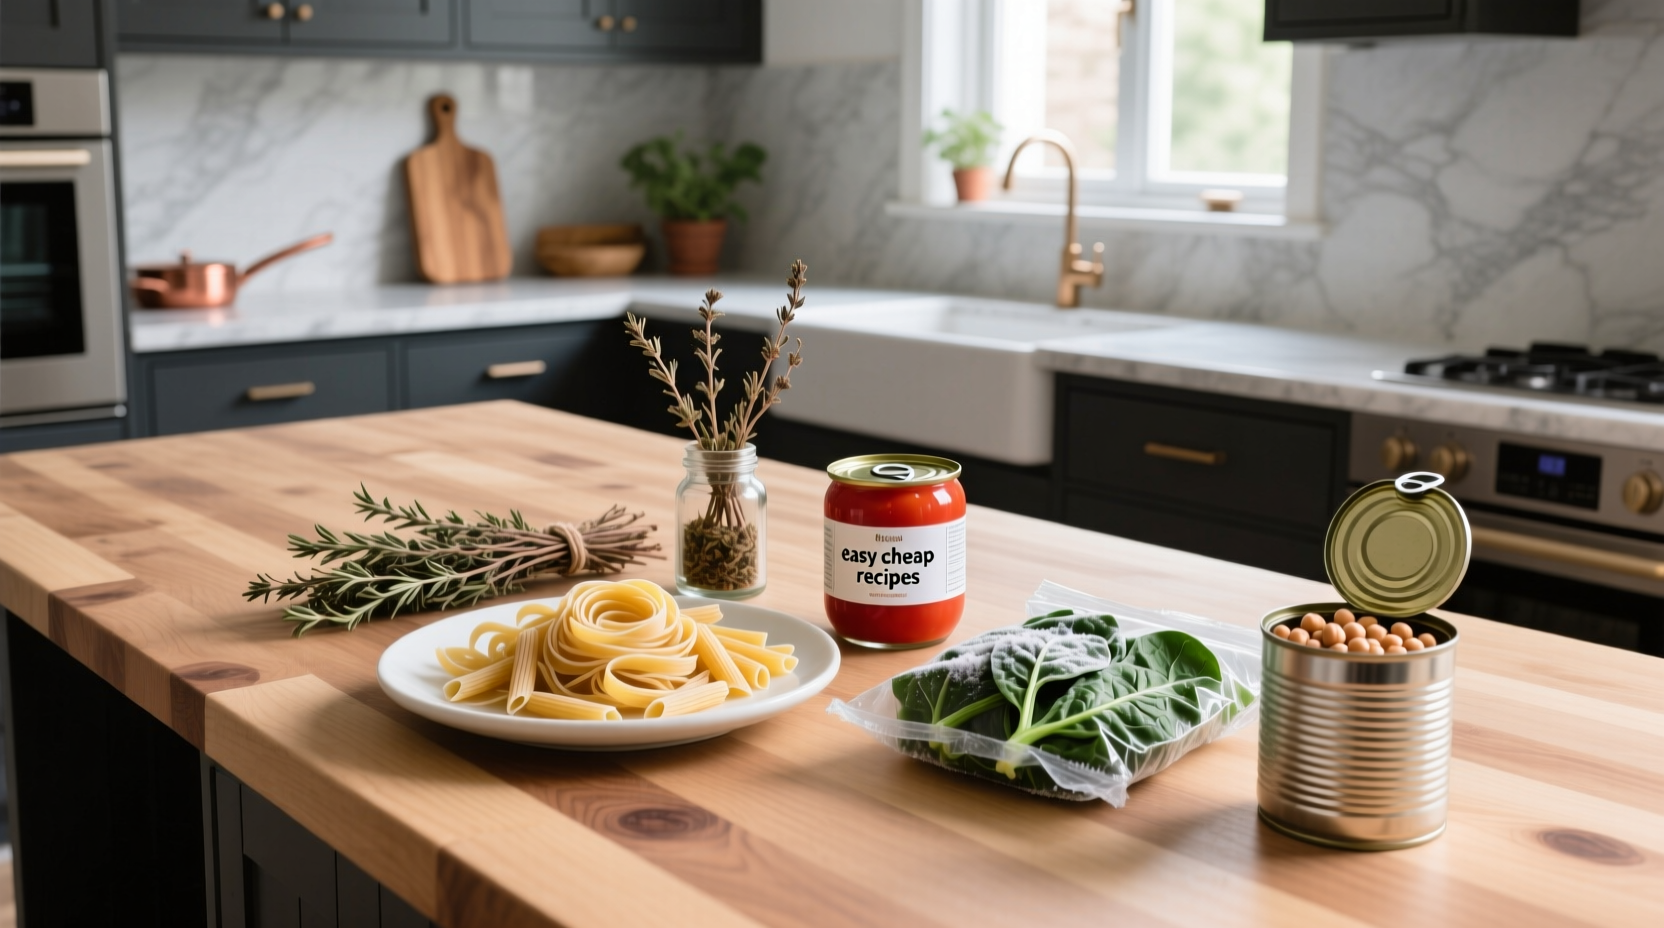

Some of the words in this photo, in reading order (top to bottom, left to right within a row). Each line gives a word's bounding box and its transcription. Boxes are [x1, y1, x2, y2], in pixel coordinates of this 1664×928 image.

[841, 547, 877, 567] easy
[881, 546, 935, 567] cheap
[856, 568, 920, 590] recipes
